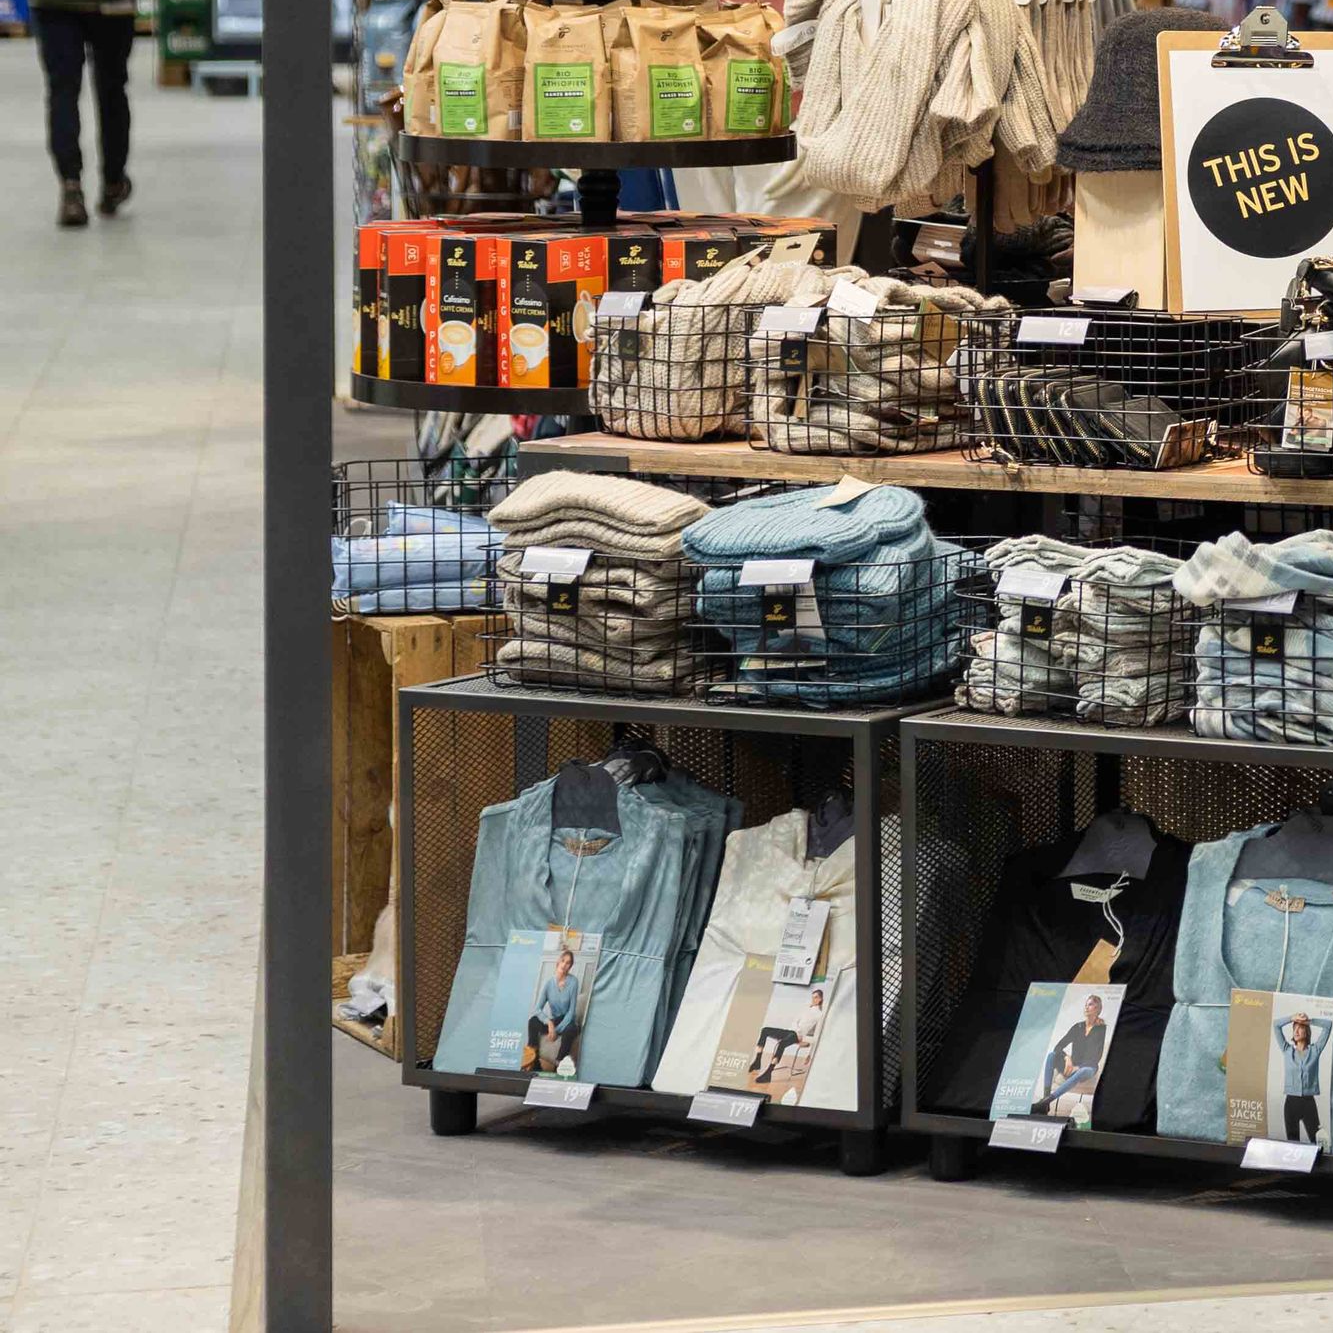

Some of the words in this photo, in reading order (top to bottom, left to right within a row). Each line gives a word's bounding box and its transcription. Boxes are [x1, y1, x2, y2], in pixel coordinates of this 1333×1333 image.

[541, 79, 586, 87] ÄTHIOPIEN
[1203, 143, 1282, 188] THIS
[1286, 132, 1320, 165] IS
[1235, 172, 1309, 219] NEW
[408, 247, 417, 260] 30
[447, 258, 467, 267] Tchibo
[517, 260, 539, 269] Tchibo
[619, 256, 648, 265] Tchibo
[696, 258, 725, 268] Tchibo
[443, 294, 471, 304] Cafissimo
[514, 297, 543, 307] Cafissimo
[527, 308, 546, 316] CREMA
[500, 334, 508, 383] PACK
[489, 1038, 521, 1050] SHIRT
[716, 1055, 748, 1069] SHIRT
[999, 1084, 1032, 1098] SHIRT
[1230, 1098, 1264, 1111] STRICK
[1230, 1108, 1264, 1121] JACKE
